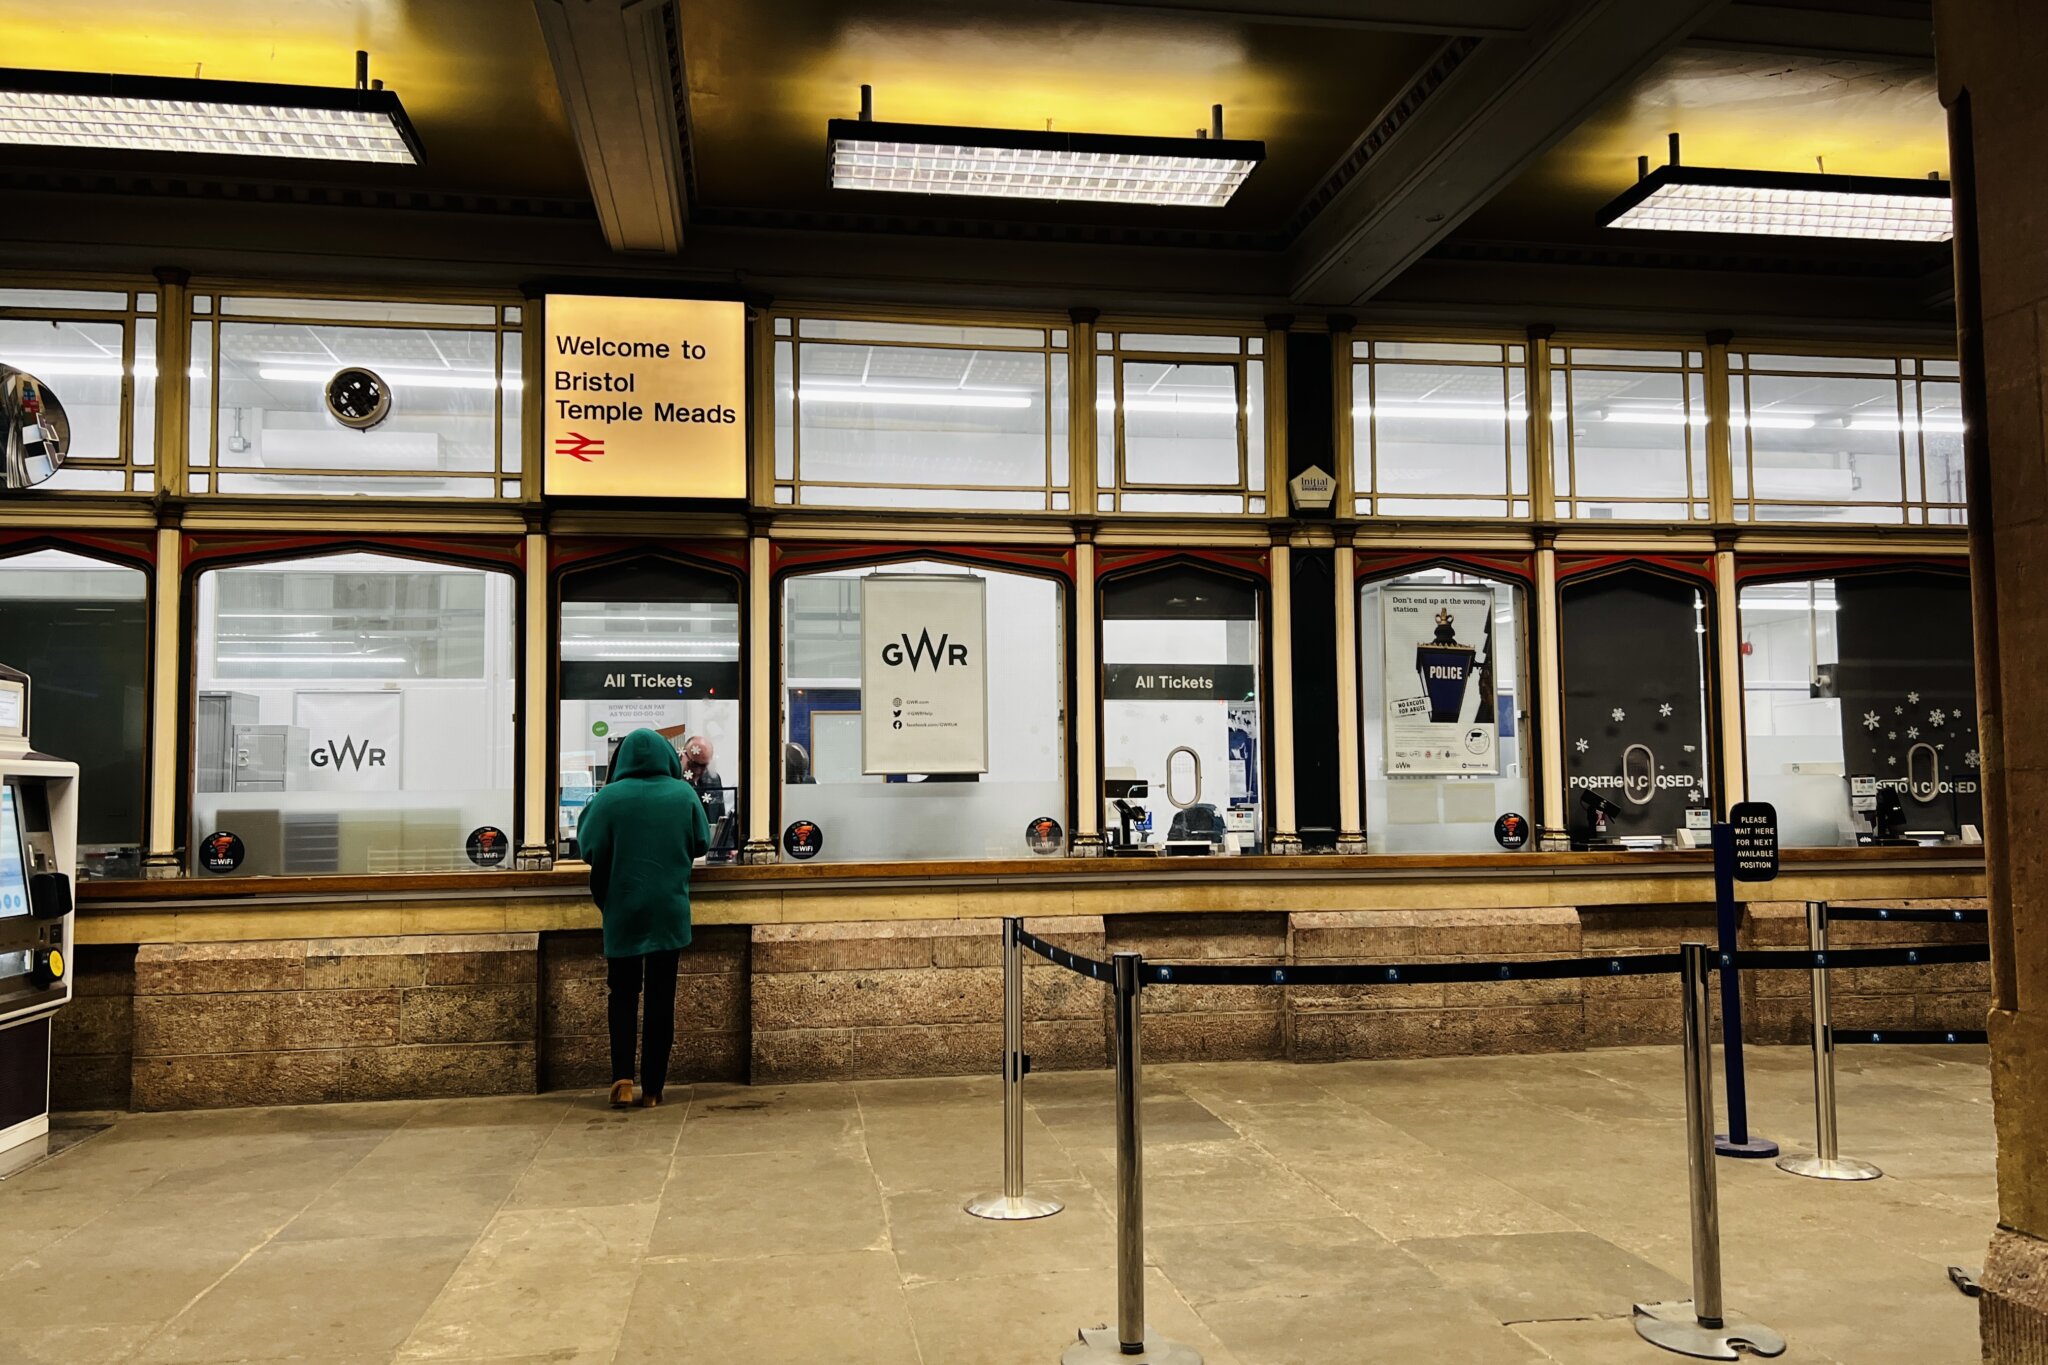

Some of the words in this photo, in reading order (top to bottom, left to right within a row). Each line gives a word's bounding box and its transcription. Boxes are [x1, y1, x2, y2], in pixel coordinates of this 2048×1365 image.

[556, 335, 670, 358] Welcome
[681, 340, 706, 360] to
[555, 371, 634, 392] Bristol
[555, 400, 643, 424] Temple
[654, 402, 736, 424] Meads
[1301, 477, 1328, 487] Initial
[882, 626, 968, 673] GWR
[1429, 666, 1463, 680] POLICE
[603, 673, 625, 688] All
[631, 673, 693, 688] Tickets
[1135, 675, 1154, 689] All
[1158, 675, 1213, 689] Tickets
[310, 733, 386, 772] GWR
[1569, 775, 1635, 788] POSITION
[1637, 775, 1694, 788] COSED
[1740, 816, 1767, 824] PLEASE
[1734, 827, 1751, 835] WAIT
[1755, 827, 1775, 835] HERE
[1736, 838, 1750, 846] FOR
[1754, 838, 1773, 846] NEXT
[1739, 861, 1772, 869] POSITION
